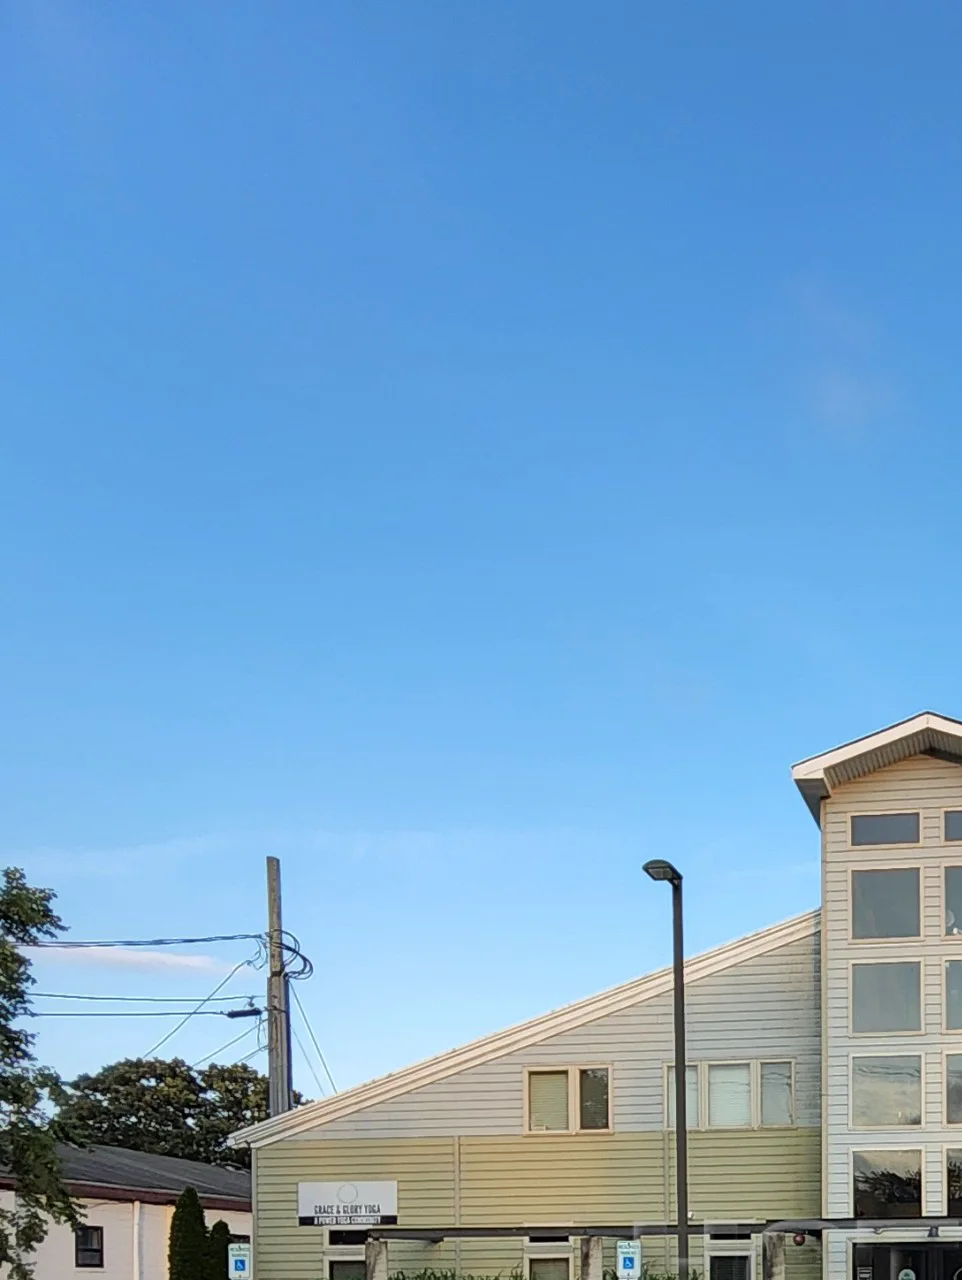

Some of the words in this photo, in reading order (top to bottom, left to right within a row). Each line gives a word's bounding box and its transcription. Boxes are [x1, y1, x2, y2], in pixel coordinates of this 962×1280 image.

[314, 1204, 335, 1215] GRACE
[336, 1204, 341, 1215] &
[342, 1204, 363, 1214] GLORY
[364, 1204, 381, 1214] YOGA
